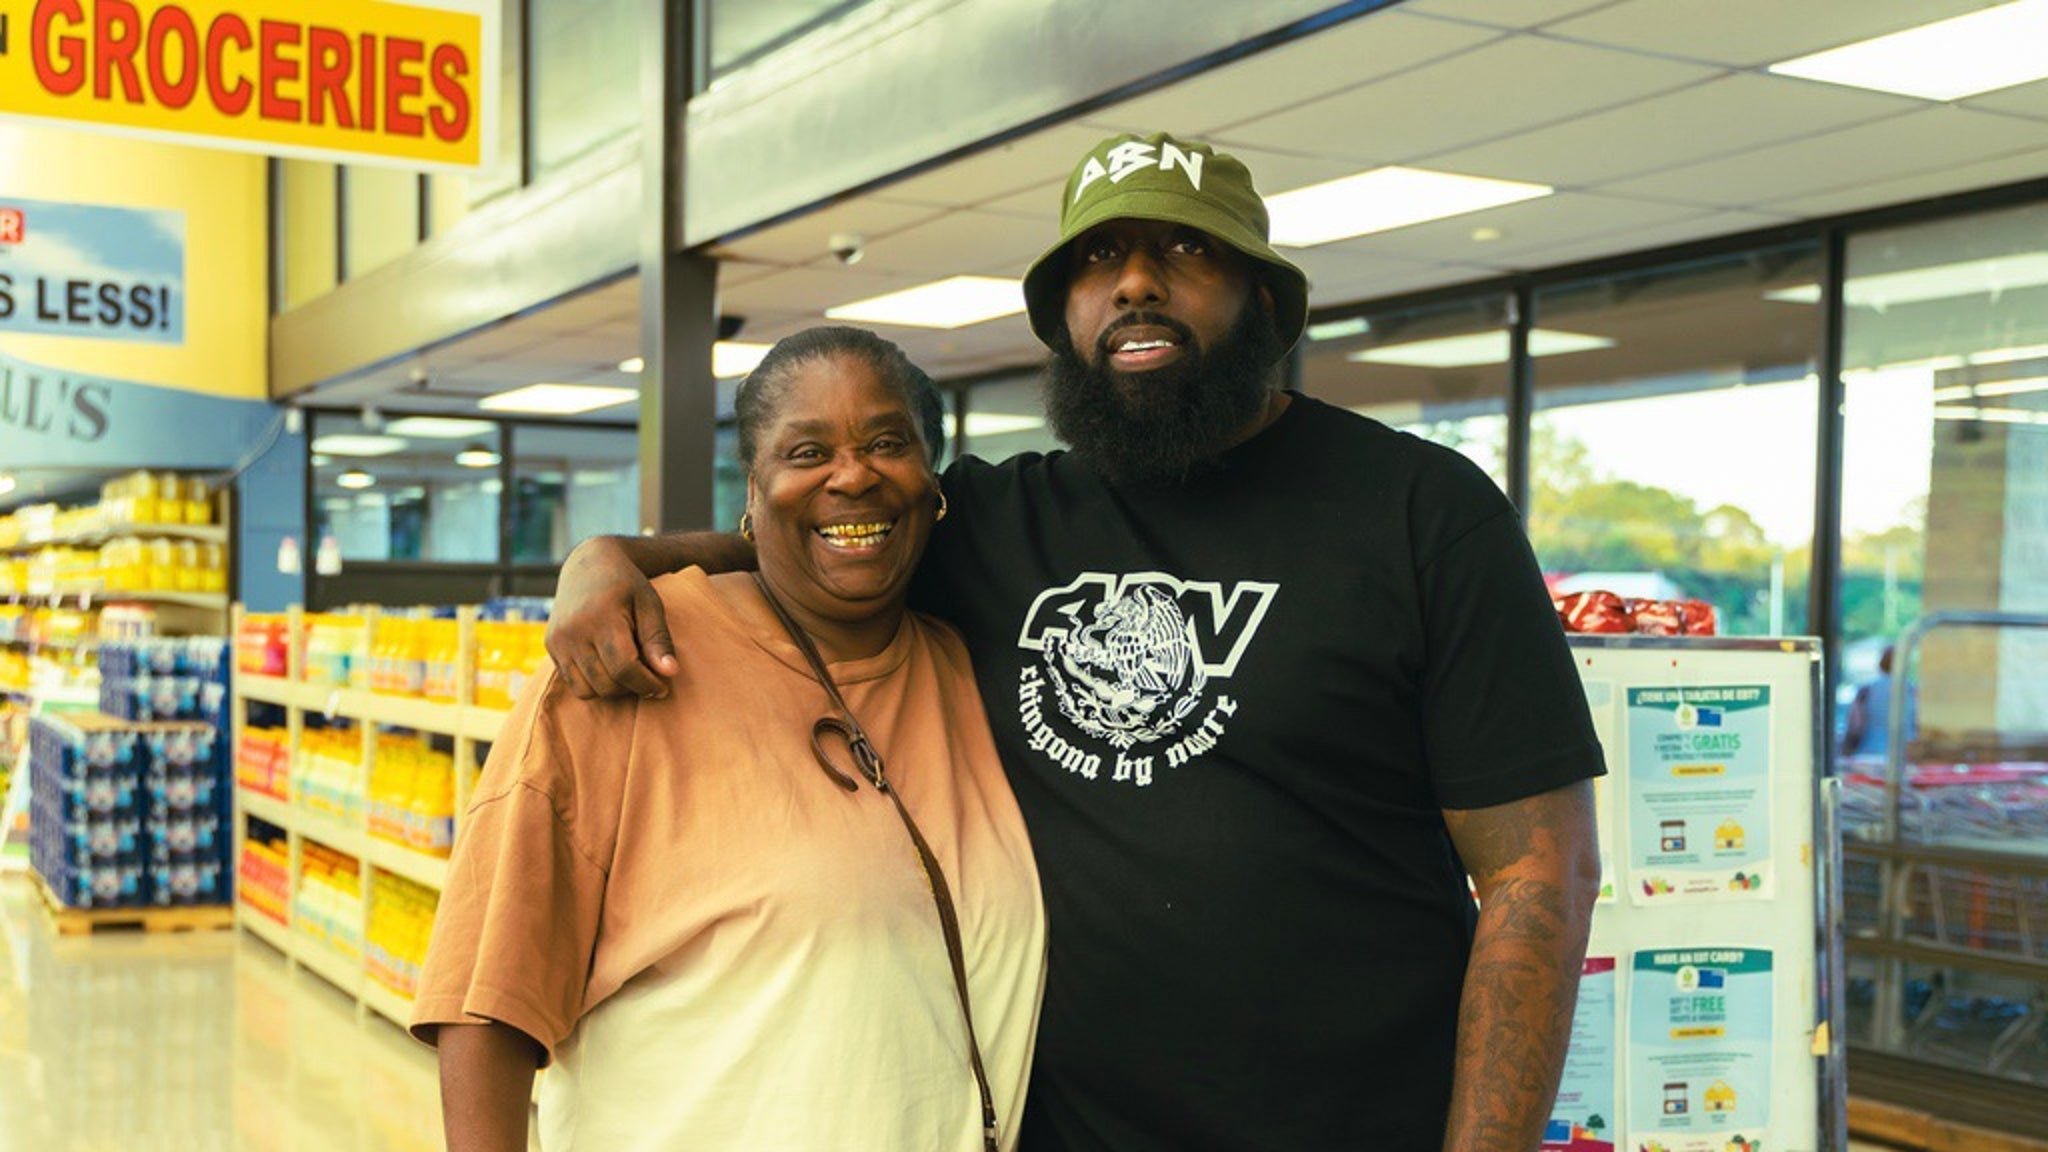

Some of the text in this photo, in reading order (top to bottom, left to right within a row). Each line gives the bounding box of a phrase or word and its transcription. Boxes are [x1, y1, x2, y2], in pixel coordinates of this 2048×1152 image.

[31, 0, 470, 143] GROCERIES
[1074, 141, 1204, 204] ABN
[37, 276, 169, 331] LESS!
[1018, 665, 1101, 780] chingona
[1112, 752, 1154, 787] by
[1693, 733, 1741, 750] GRATIS
[1692, 995, 1725, 1012] FREE
